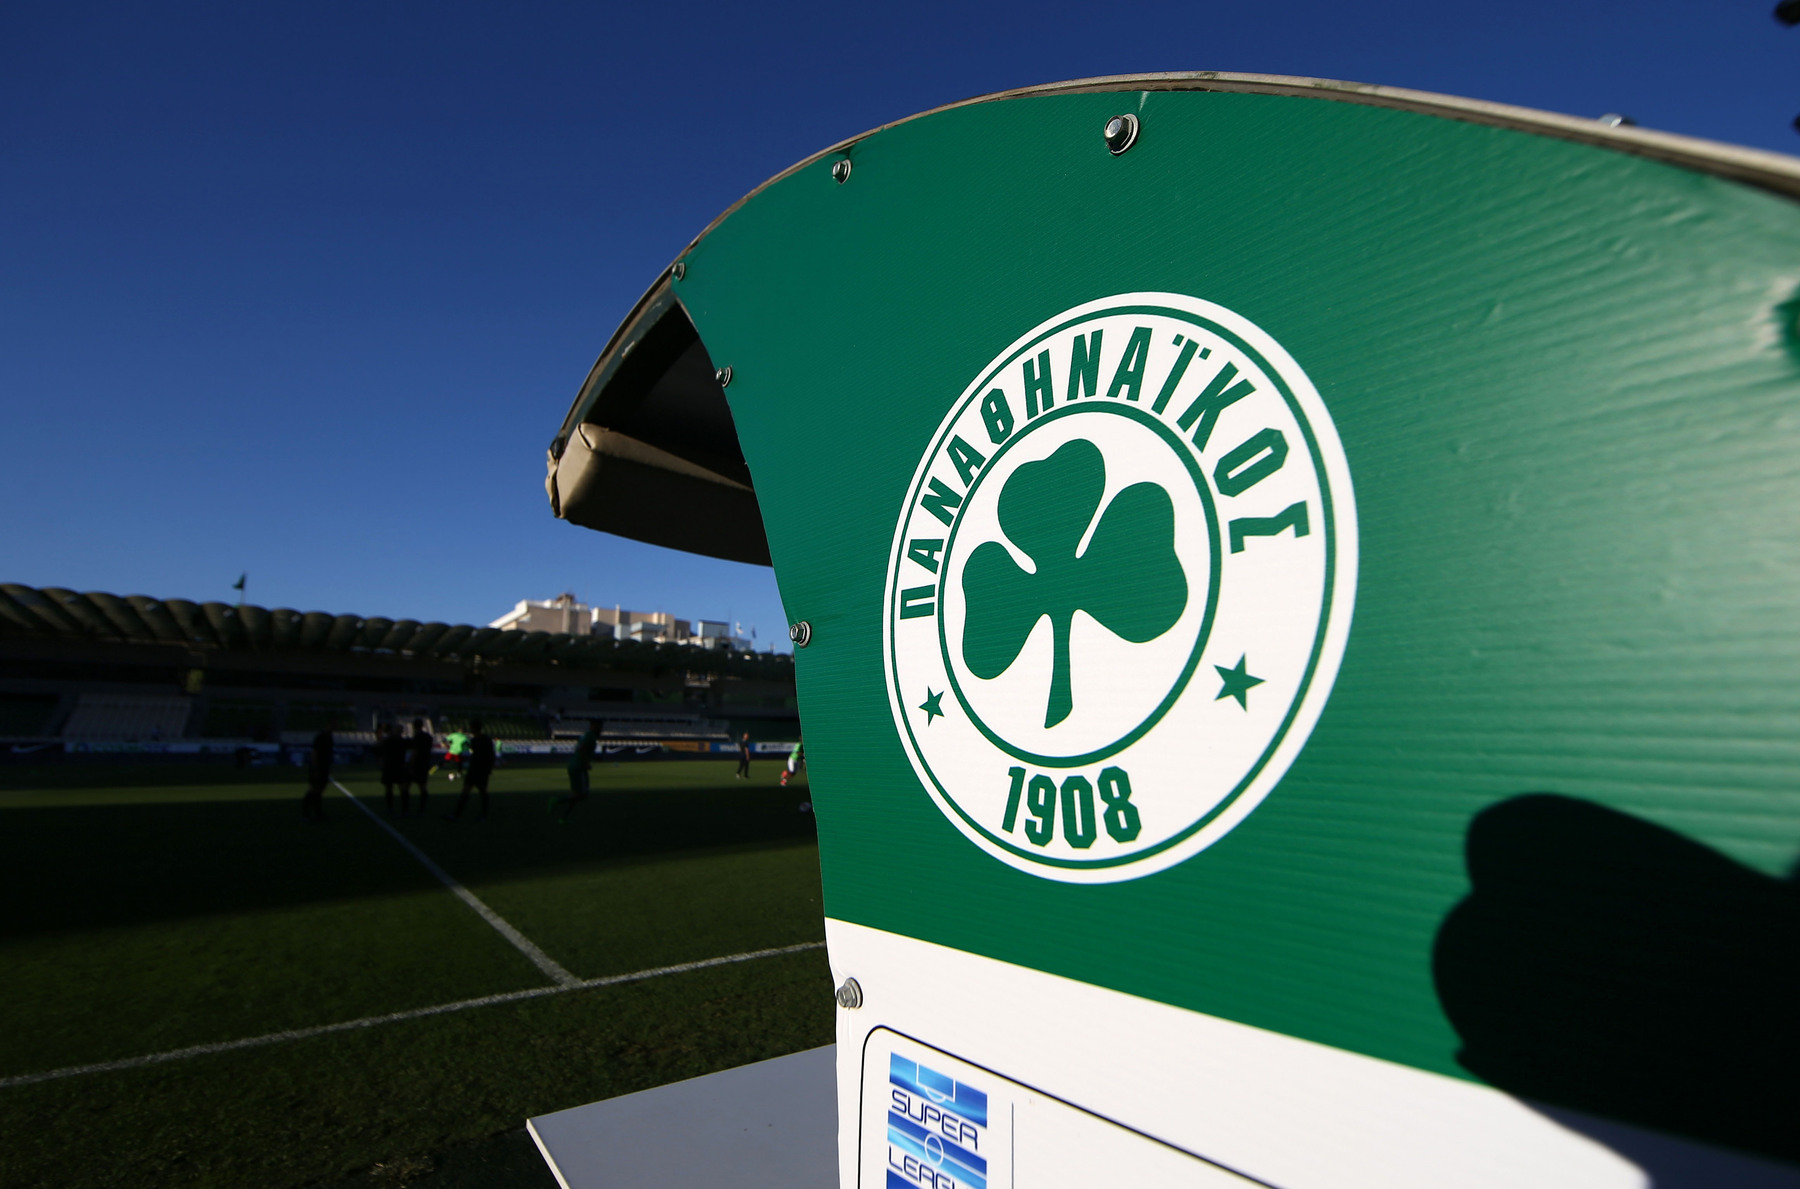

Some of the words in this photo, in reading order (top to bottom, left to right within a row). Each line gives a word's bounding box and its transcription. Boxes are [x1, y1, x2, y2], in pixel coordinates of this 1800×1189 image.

[900, 326, 1310, 620] ΠΑΝΑΘΗΝΑΪΚΟΣ
[1002, 766, 1142, 849] 1908
[892, 1089, 978, 1151] SUPER
